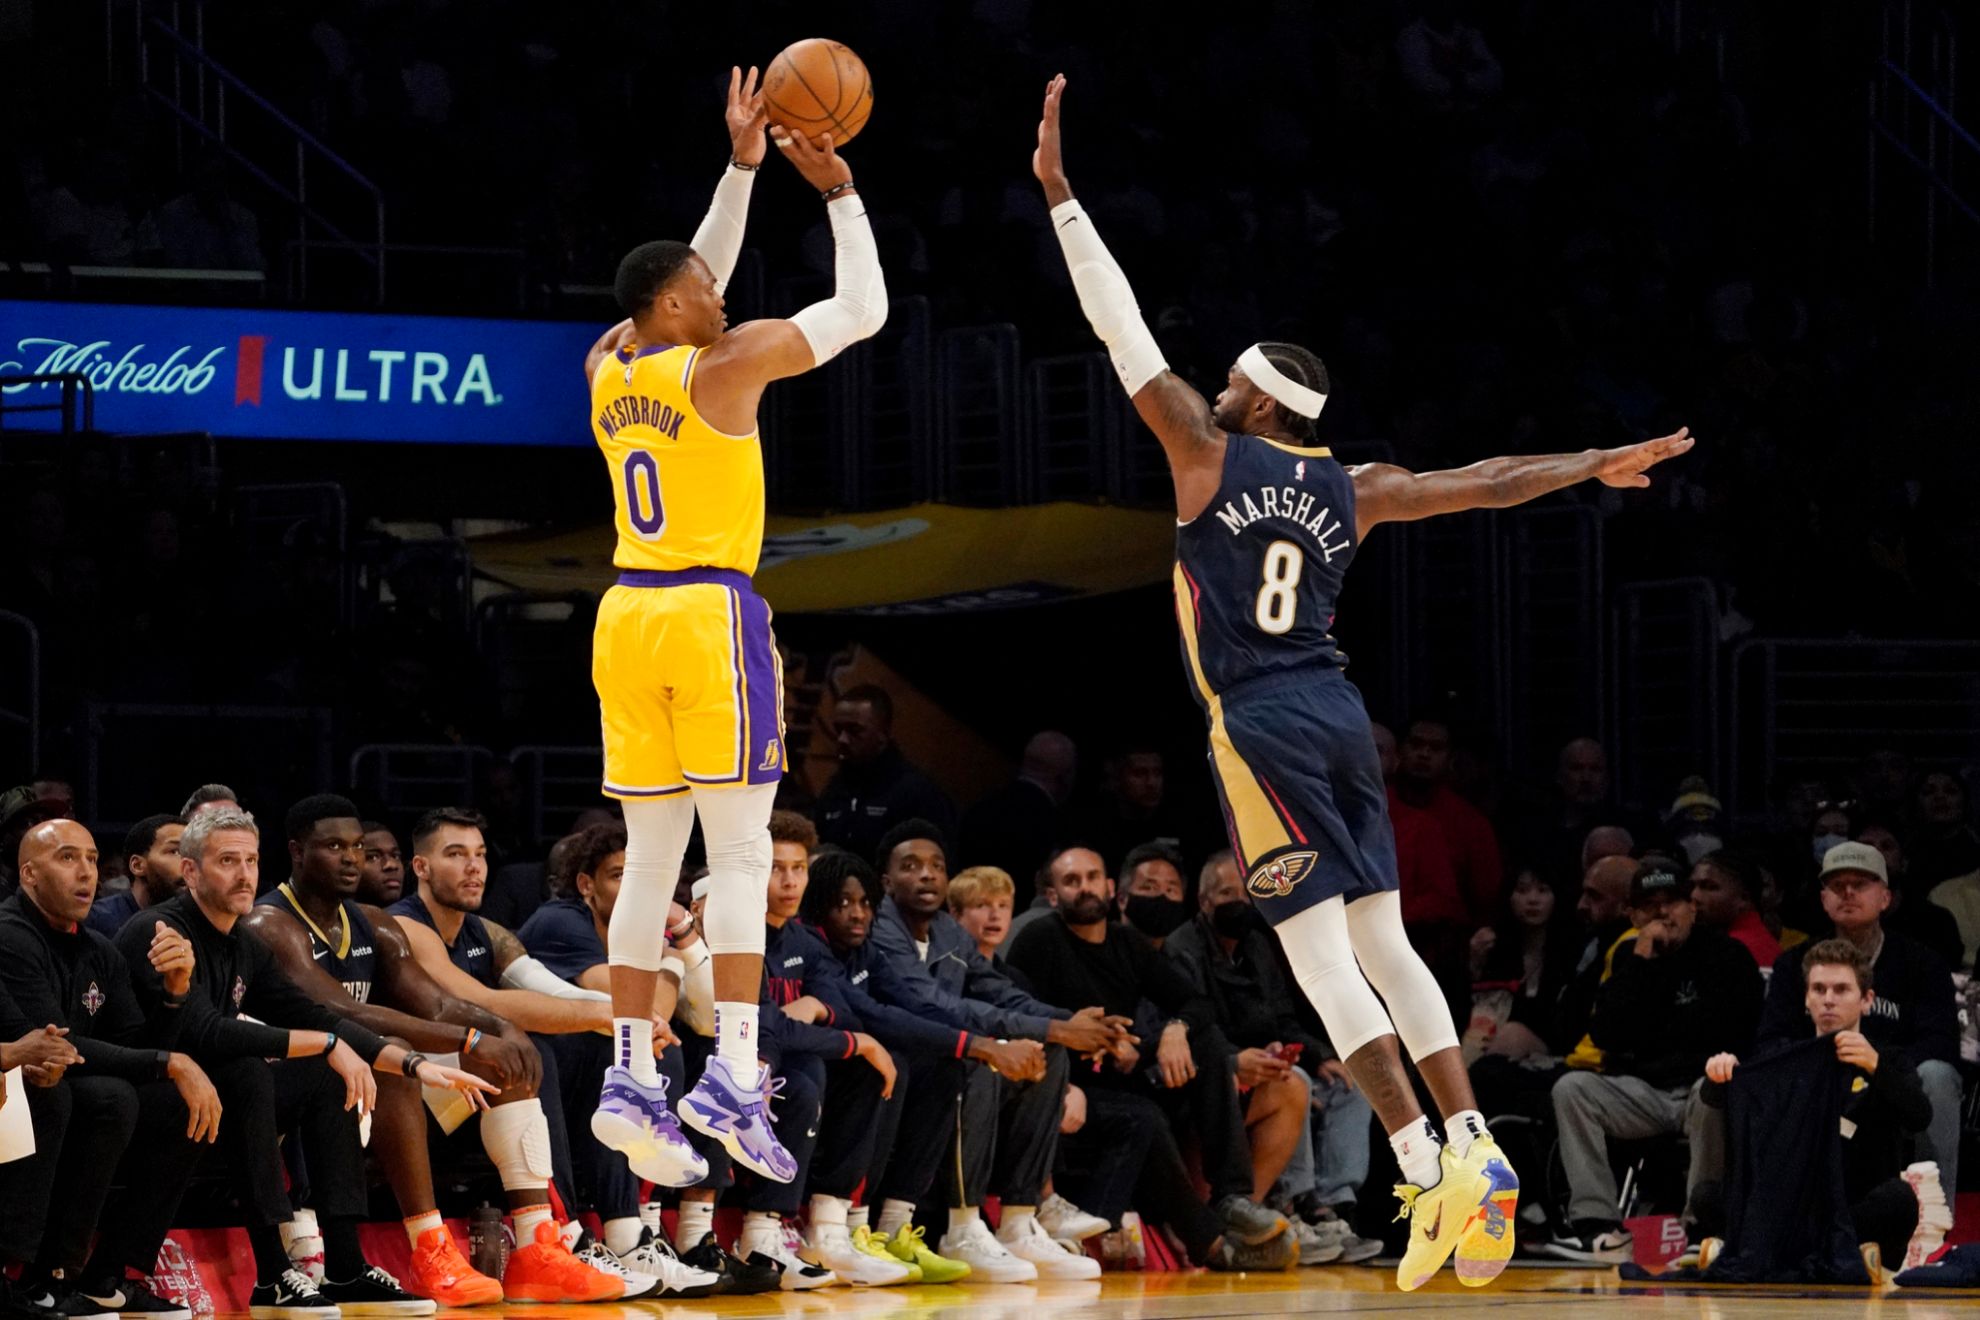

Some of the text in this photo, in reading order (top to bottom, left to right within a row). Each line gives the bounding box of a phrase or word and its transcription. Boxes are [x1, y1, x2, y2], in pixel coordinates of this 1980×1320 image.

[0, 337, 227, 396] Michelob
[598, 395, 686, 441] WESTBROOK
[624, 448, 667, 541] 0
[1215, 486, 1350, 563] MARSHALL
[1256, 540, 1303, 634] 8
